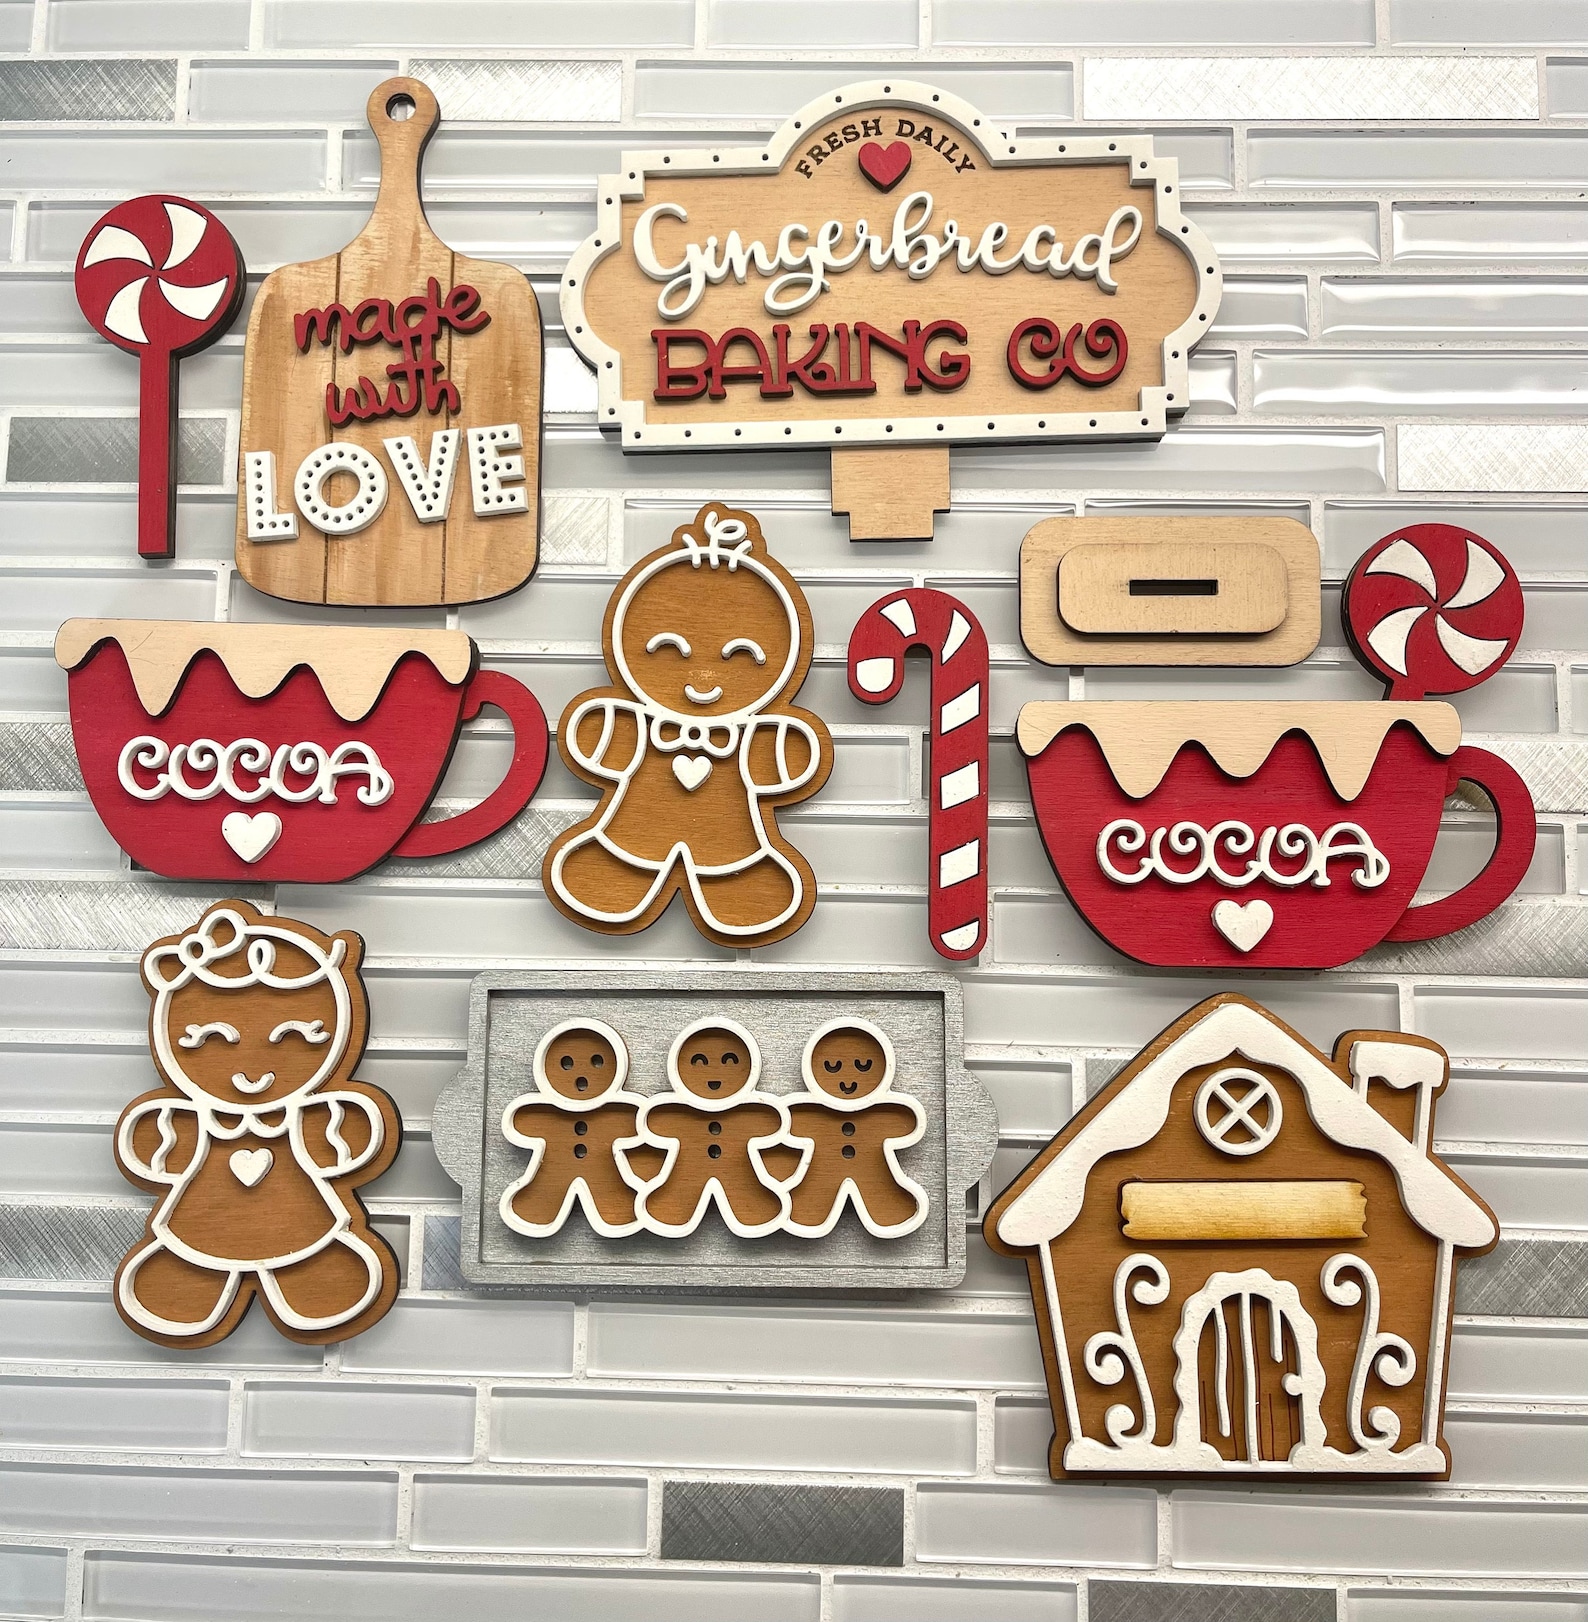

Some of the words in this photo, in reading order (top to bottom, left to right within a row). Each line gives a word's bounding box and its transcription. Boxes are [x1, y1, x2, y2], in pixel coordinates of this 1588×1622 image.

[794, 116, 883, 179] FRESH
[895, 119, 976, 174] DAILY
[633, 190, 1144, 321] Gingerbread
[293, 276, 492, 354] made
[325, 337, 461, 428] with
[651, 319, 971, 401] BAKING
[1006, 317, 1129, 391] CO
[245, 423, 530, 542] LOVE
[117, 735, 395, 807] COCOA
[1096, 818, 1391, 888] COCOA
